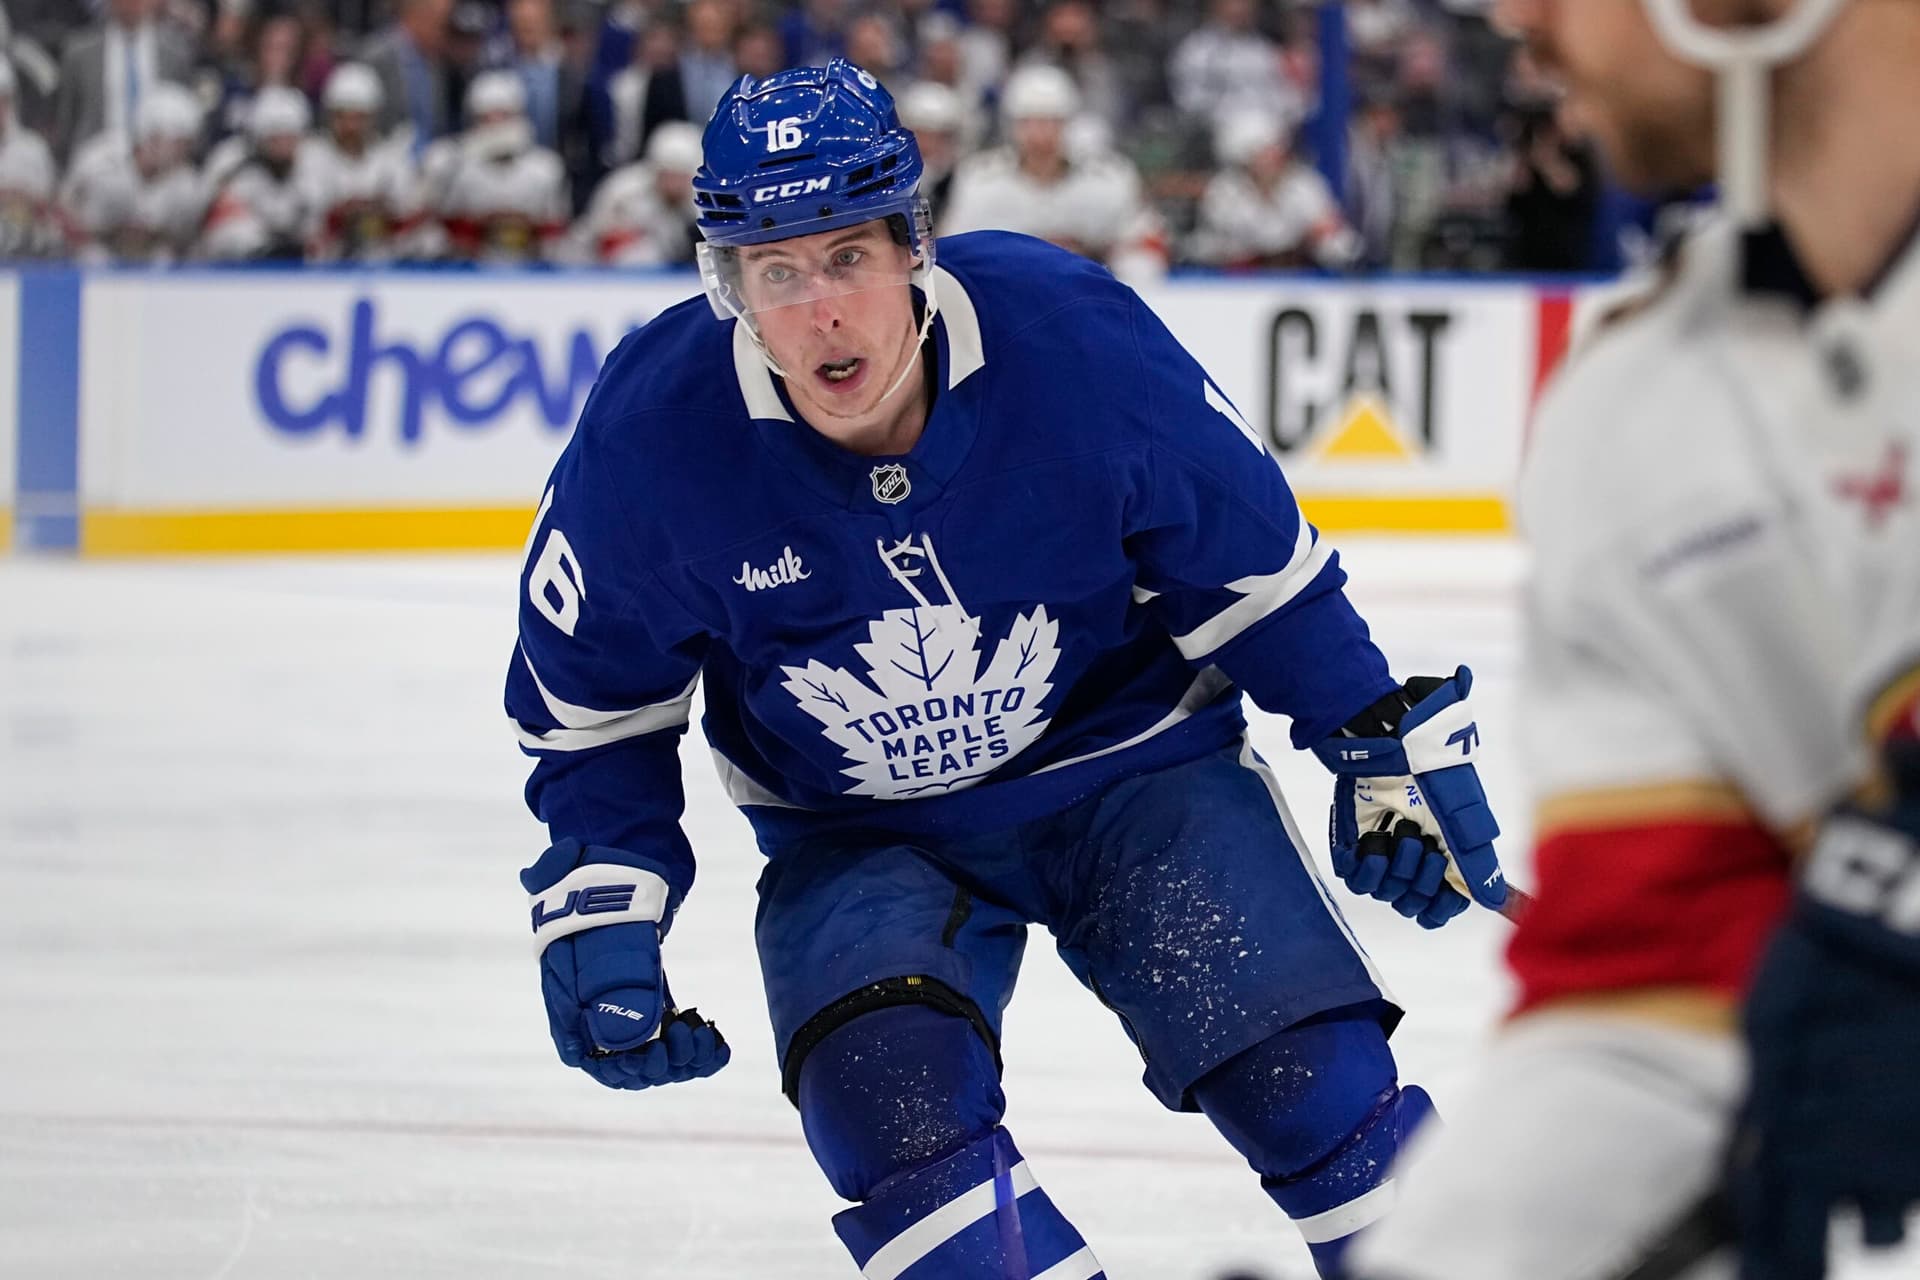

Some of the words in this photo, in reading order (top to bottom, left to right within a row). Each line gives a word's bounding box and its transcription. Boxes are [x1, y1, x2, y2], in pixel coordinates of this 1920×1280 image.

[766, 116, 802, 153] 16
[753, 175, 833, 203] CCM
[1267, 307, 1452, 453] CAT
[881, 473, 901, 498] NHL
[732, 545, 812, 592] Milk
[845, 686, 1026, 744] TORONTO
[881, 715, 1006, 760] MAPLE
[887, 738, 1010, 781] LEAFS
[531, 883, 637, 934] UE
[597, 1003, 644, 1022] TRUE
